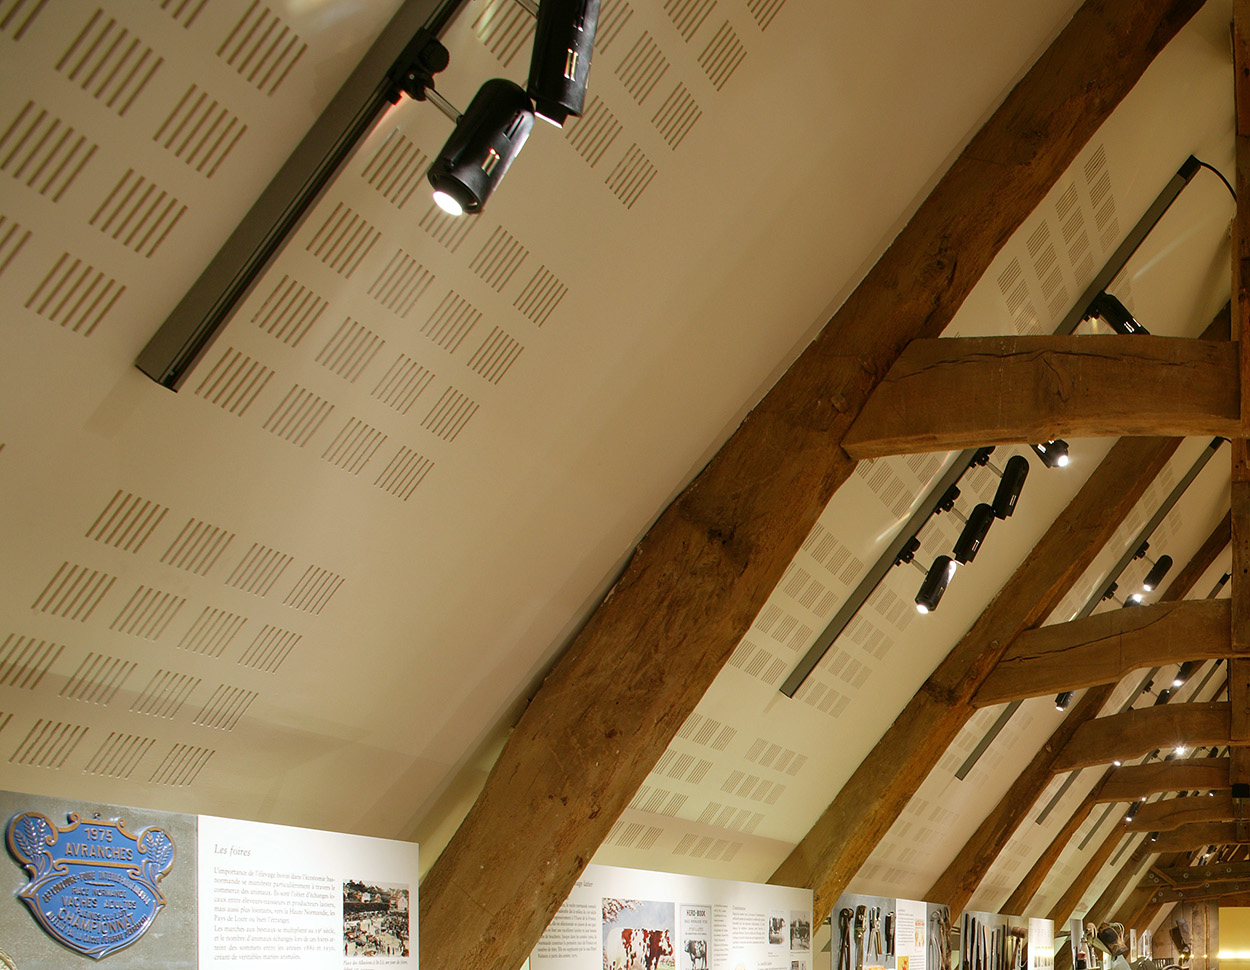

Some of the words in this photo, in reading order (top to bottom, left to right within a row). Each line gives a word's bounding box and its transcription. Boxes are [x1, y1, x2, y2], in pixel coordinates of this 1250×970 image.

[84, 828, 113, 842] 1975
[65, 843, 133, 861] AVRANCHES
[214, 843, 227, 854] Les
[229, 844, 250, 857] foires
[62, 896, 97, 908] VACHES
[104, 899, 136, 909] ADULTES
[58, 908, 136, 934] CHAMPIONNAT
